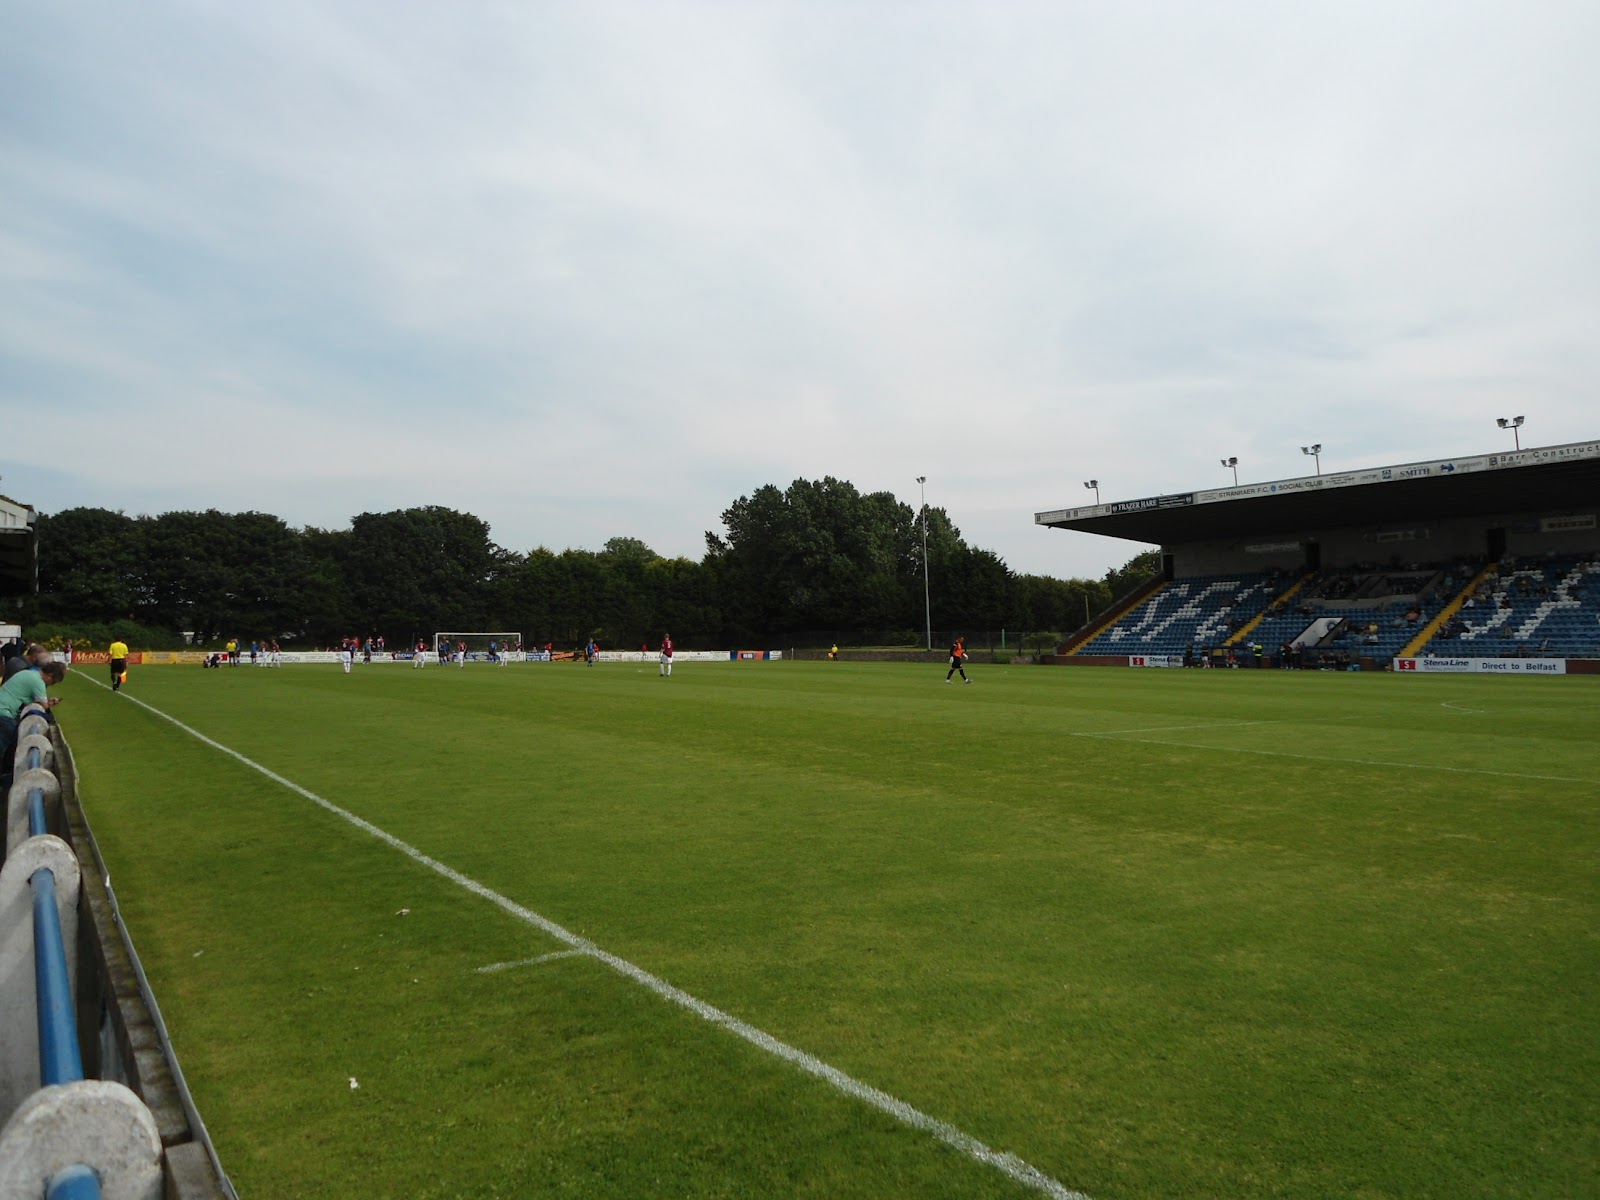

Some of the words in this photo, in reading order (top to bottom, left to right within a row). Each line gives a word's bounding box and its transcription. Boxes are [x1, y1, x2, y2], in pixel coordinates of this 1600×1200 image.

[1500, 454, 1525, 462] Barr
[1400, 468, 1430, 477] SMITH
[1218, 488, 1255, 499] STRANRAER
[1278, 482, 1302, 491] SOCIAL
[1118, 501, 1139, 511] FRAZER
[1482, 662, 1507, 670] Direct
[1526, 663, 1557, 671] Belfast
